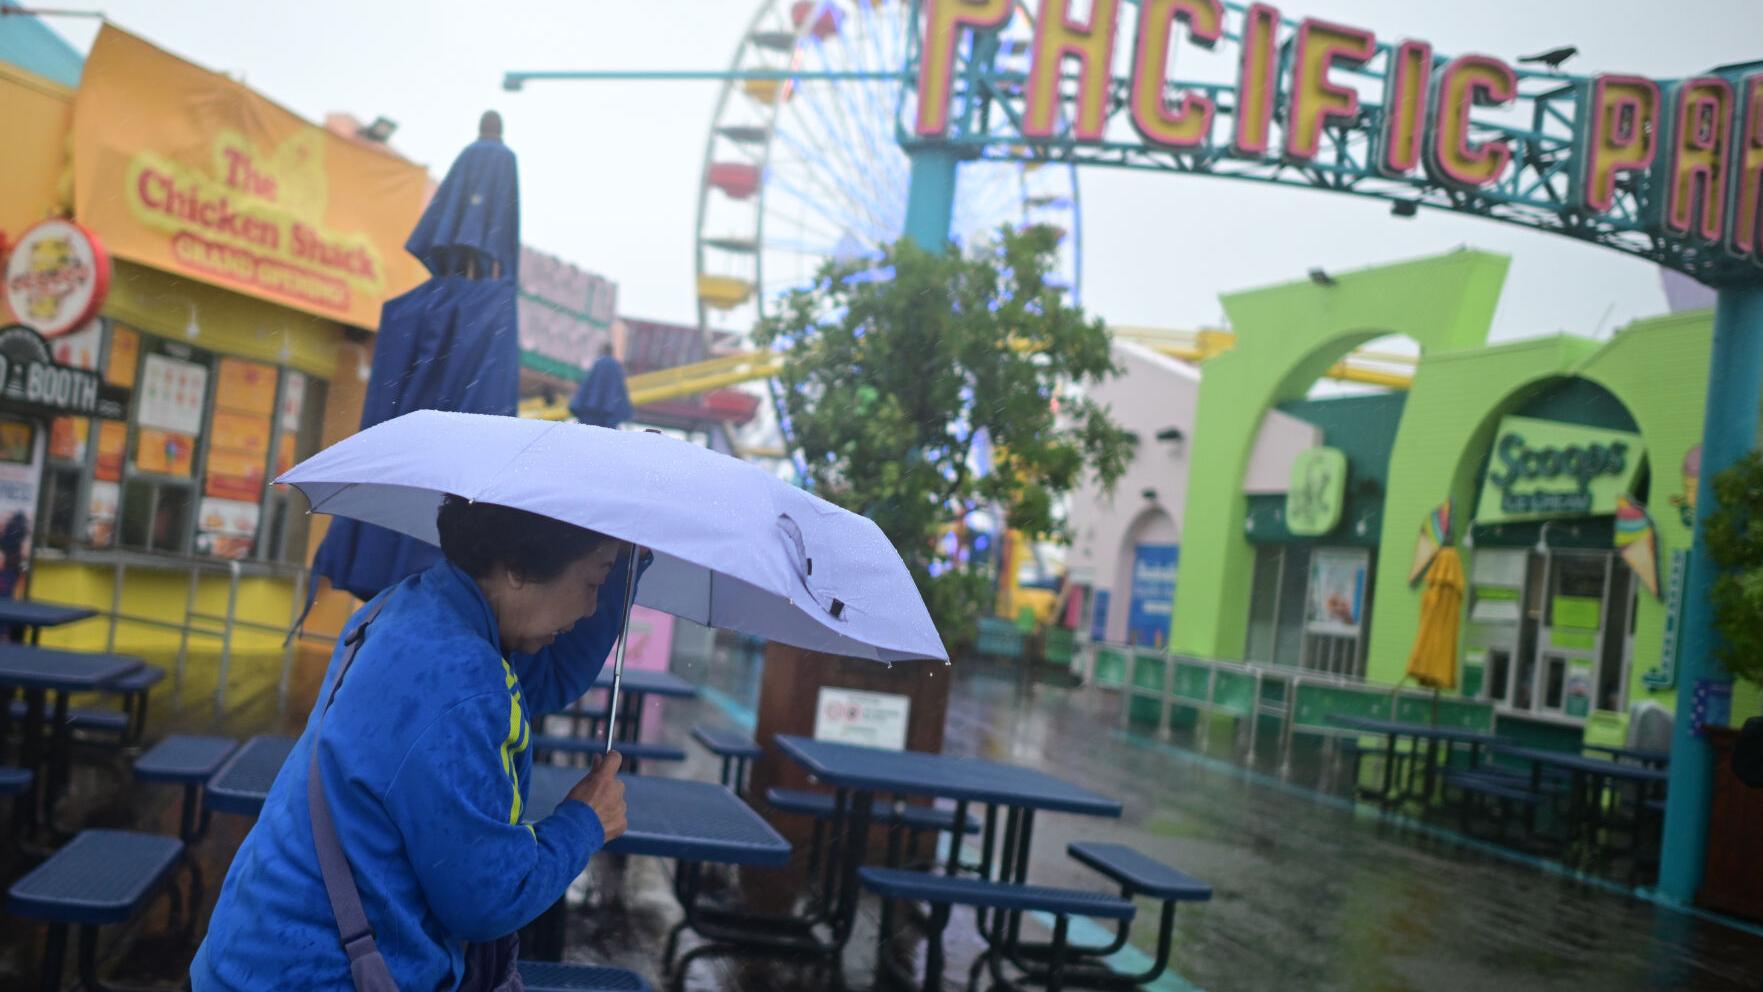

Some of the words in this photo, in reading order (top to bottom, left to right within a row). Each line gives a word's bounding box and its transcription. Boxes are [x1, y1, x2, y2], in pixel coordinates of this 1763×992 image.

[916, 0, 1519, 187] PACIFIC
[224, 145, 278, 202] The
[137, 167, 279, 251] Chicken
[291, 222, 376, 280] Shack
[27, 361, 98, 411] BOOTH
[1490, 432, 1628, 494] Scoops
